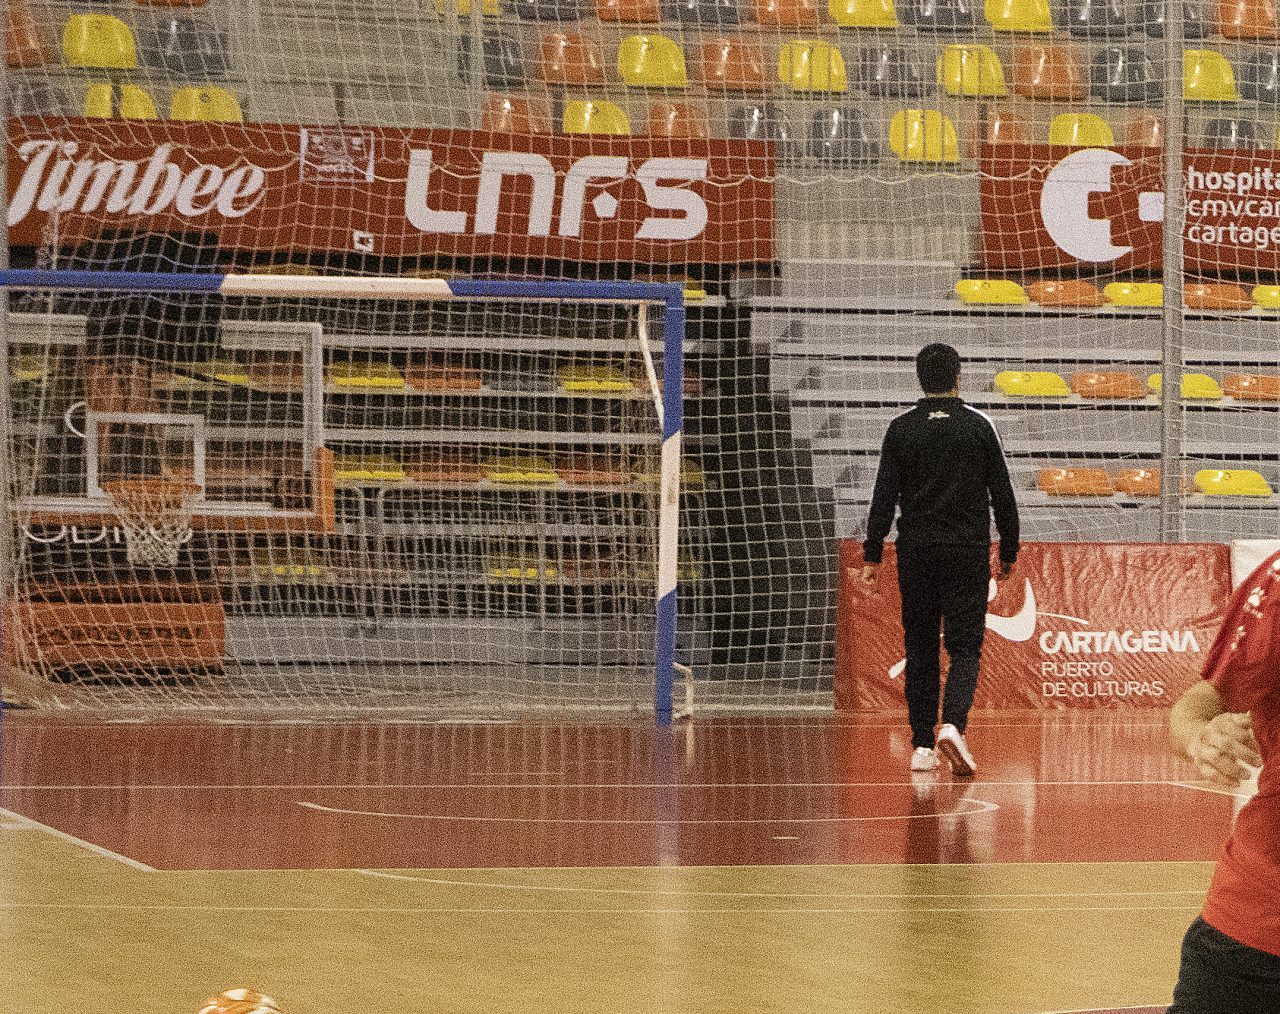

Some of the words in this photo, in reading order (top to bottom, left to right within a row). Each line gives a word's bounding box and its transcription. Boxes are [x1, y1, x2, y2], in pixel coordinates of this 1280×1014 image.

[8, 140, 266, 227] Jimbee
[1039, 630, 1201, 655] CARTAGENA
[1042, 660, 1114, 678] PUERTO
[1042, 681, 1067, 697] DE
[1070, 680, 1165, 698] CULTURAS
